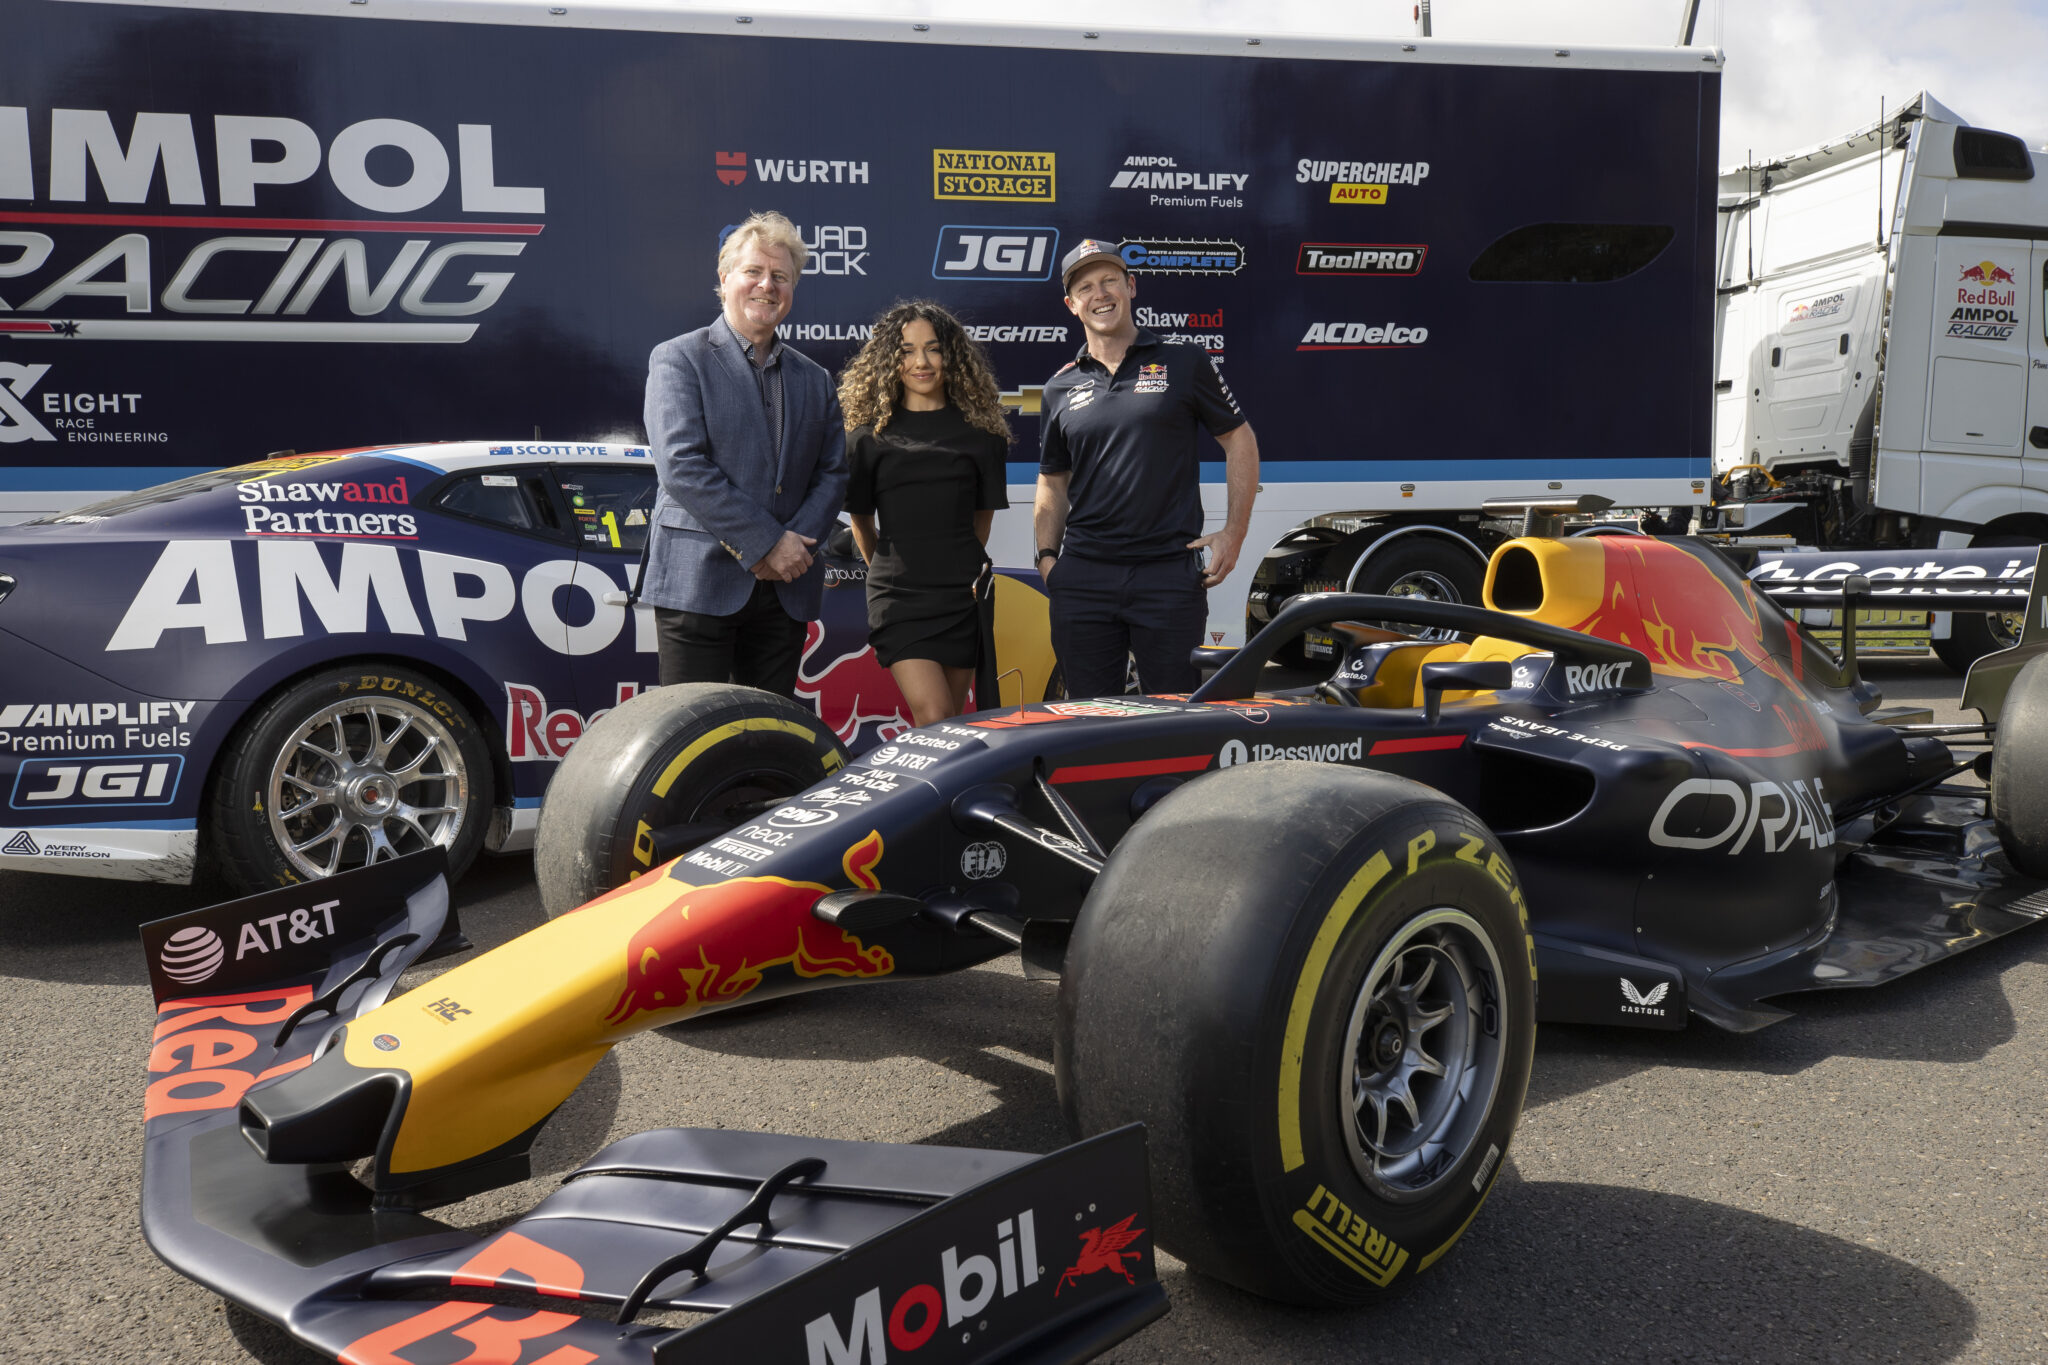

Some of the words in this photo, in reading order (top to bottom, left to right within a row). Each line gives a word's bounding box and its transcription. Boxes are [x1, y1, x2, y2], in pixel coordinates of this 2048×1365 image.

[939, 153, 1051, 172] NATIONAL
[1124, 155, 1177, 167] AMPOL
[1132, 172, 1249, 191] AMPLIFY
[1296, 158, 1430, 186] SUPERCHEAP
[944, 176, 1046, 195] STORAGE
[1336, 187, 1381, 199] AUTO
[1150, 194, 1207, 208] Premium
[1210, 196, 1243, 208] Fuels
[796, 226, 867, 250] UAD
[801, 251, 867, 275] OCK
[944, 235, 1048, 272] JGI
[1120, 244, 1236, 268] COMPLETE
[1307, 250, 1414, 270] ToolPRO
[1812, 294, 1845, 308] AMPOL
[1957, 288, 1986, 304] Red
[1988, 290, 2015, 306] Bull
[1950, 308, 2019, 323] AMPOL
[796, 324, 874, 340] HOLLAN
[961, 325, 1068, 342] REIGHTER
[1301, 322, 1428, 344] ACDelco
[1947, 324, 2014, 337] RACING
[43, 393, 142, 413] EIGHT
[55, 418, 95, 429] RACE
[68, 431, 169, 442] ENGINEERING
[516, 445, 571, 456] SCOTT
[576, 446, 608, 456] PYE
[241, 505, 418, 534] Partners
[601, 511, 621, 548] 1
[825, 568, 868, 580] irtouch
[1565, 661, 1632, 694] ROKT
[25, 701, 196, 727] AMPLIFY
[1500, 715, 1568, 736] JEANS
[125, 726, 191, 748] Fuels
[1567, 733, 1629, 752] PEPE
[1252, 737, 1362, 763] 1Password
[892, 752, 938, 770] AT&T
[26, 763, 169, 800] JGI
[840, 773, 899, 792] TRADE
[862, 769, 897, 782] AVA
[774, 806, 824, 823] CDW
[44, 850, 110, 858] DENNISON
[710, 837, 774, 862] PIRELLI
[684, 851, 734, 872] Mobil
[1406, 829, 1436, 876] P
[1455, 832, 1539, 981] ZERO
[235, 899, 341, 961] AT&T
[1621, 1005, 1665, 1016] CASTORE
[1292, 1184, 1410, 1288] PIRELLI
[805, 1208, 1039, 1365] Mobil
